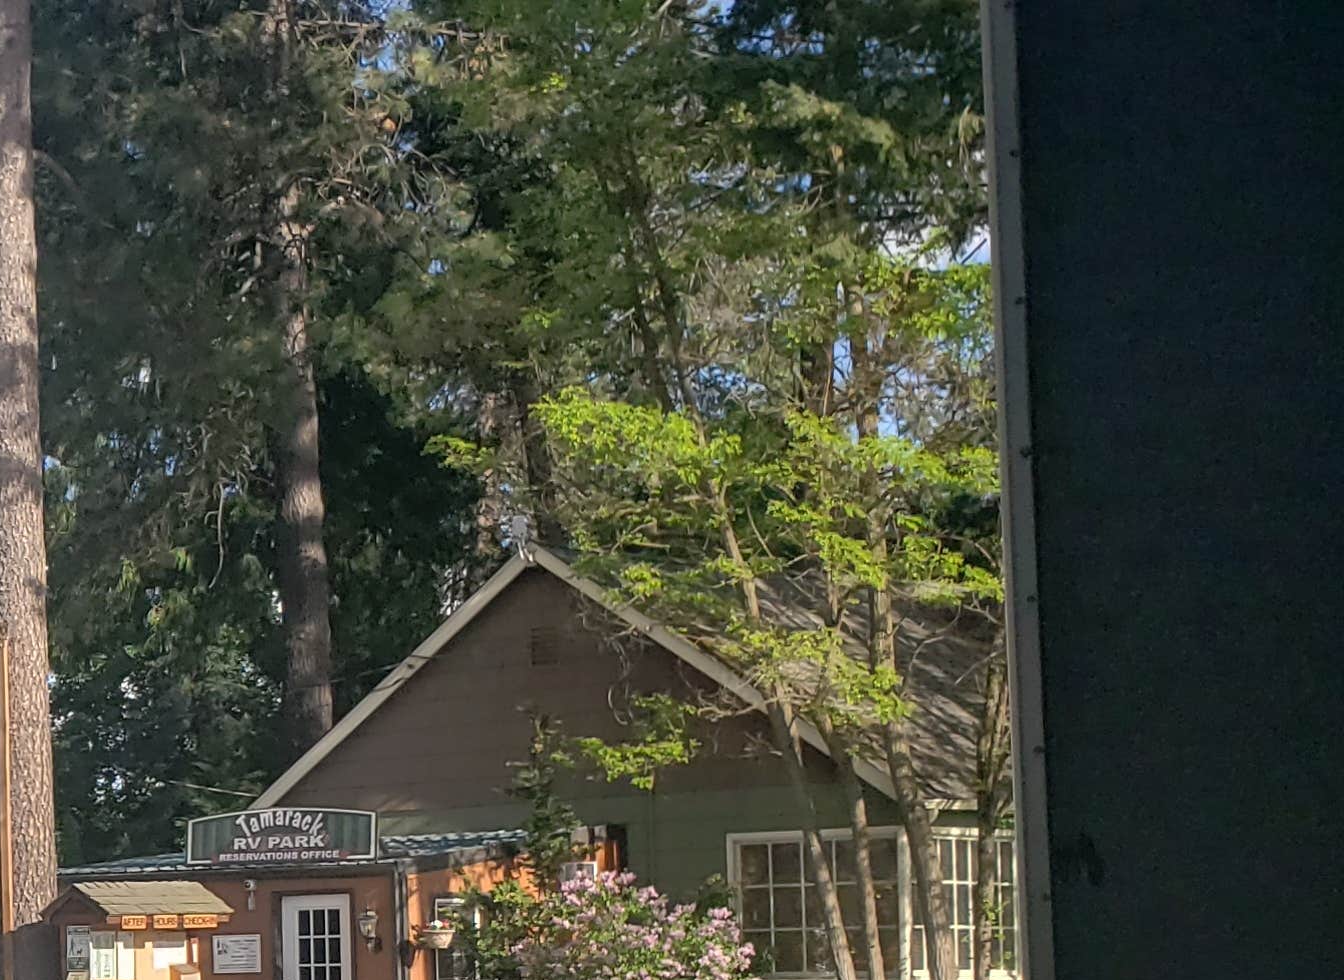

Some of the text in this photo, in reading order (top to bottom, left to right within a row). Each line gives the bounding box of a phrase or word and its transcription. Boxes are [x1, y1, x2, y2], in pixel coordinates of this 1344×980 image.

[235, 810, 325, 837] Tamarack
[233, 835, 326, 850] RV PARK
[218, 850, 340, 862] RESERVATIONS OFFICE
[123, 917, 145, 927] AFTER
[154, 917, 177, 926] HOURS
